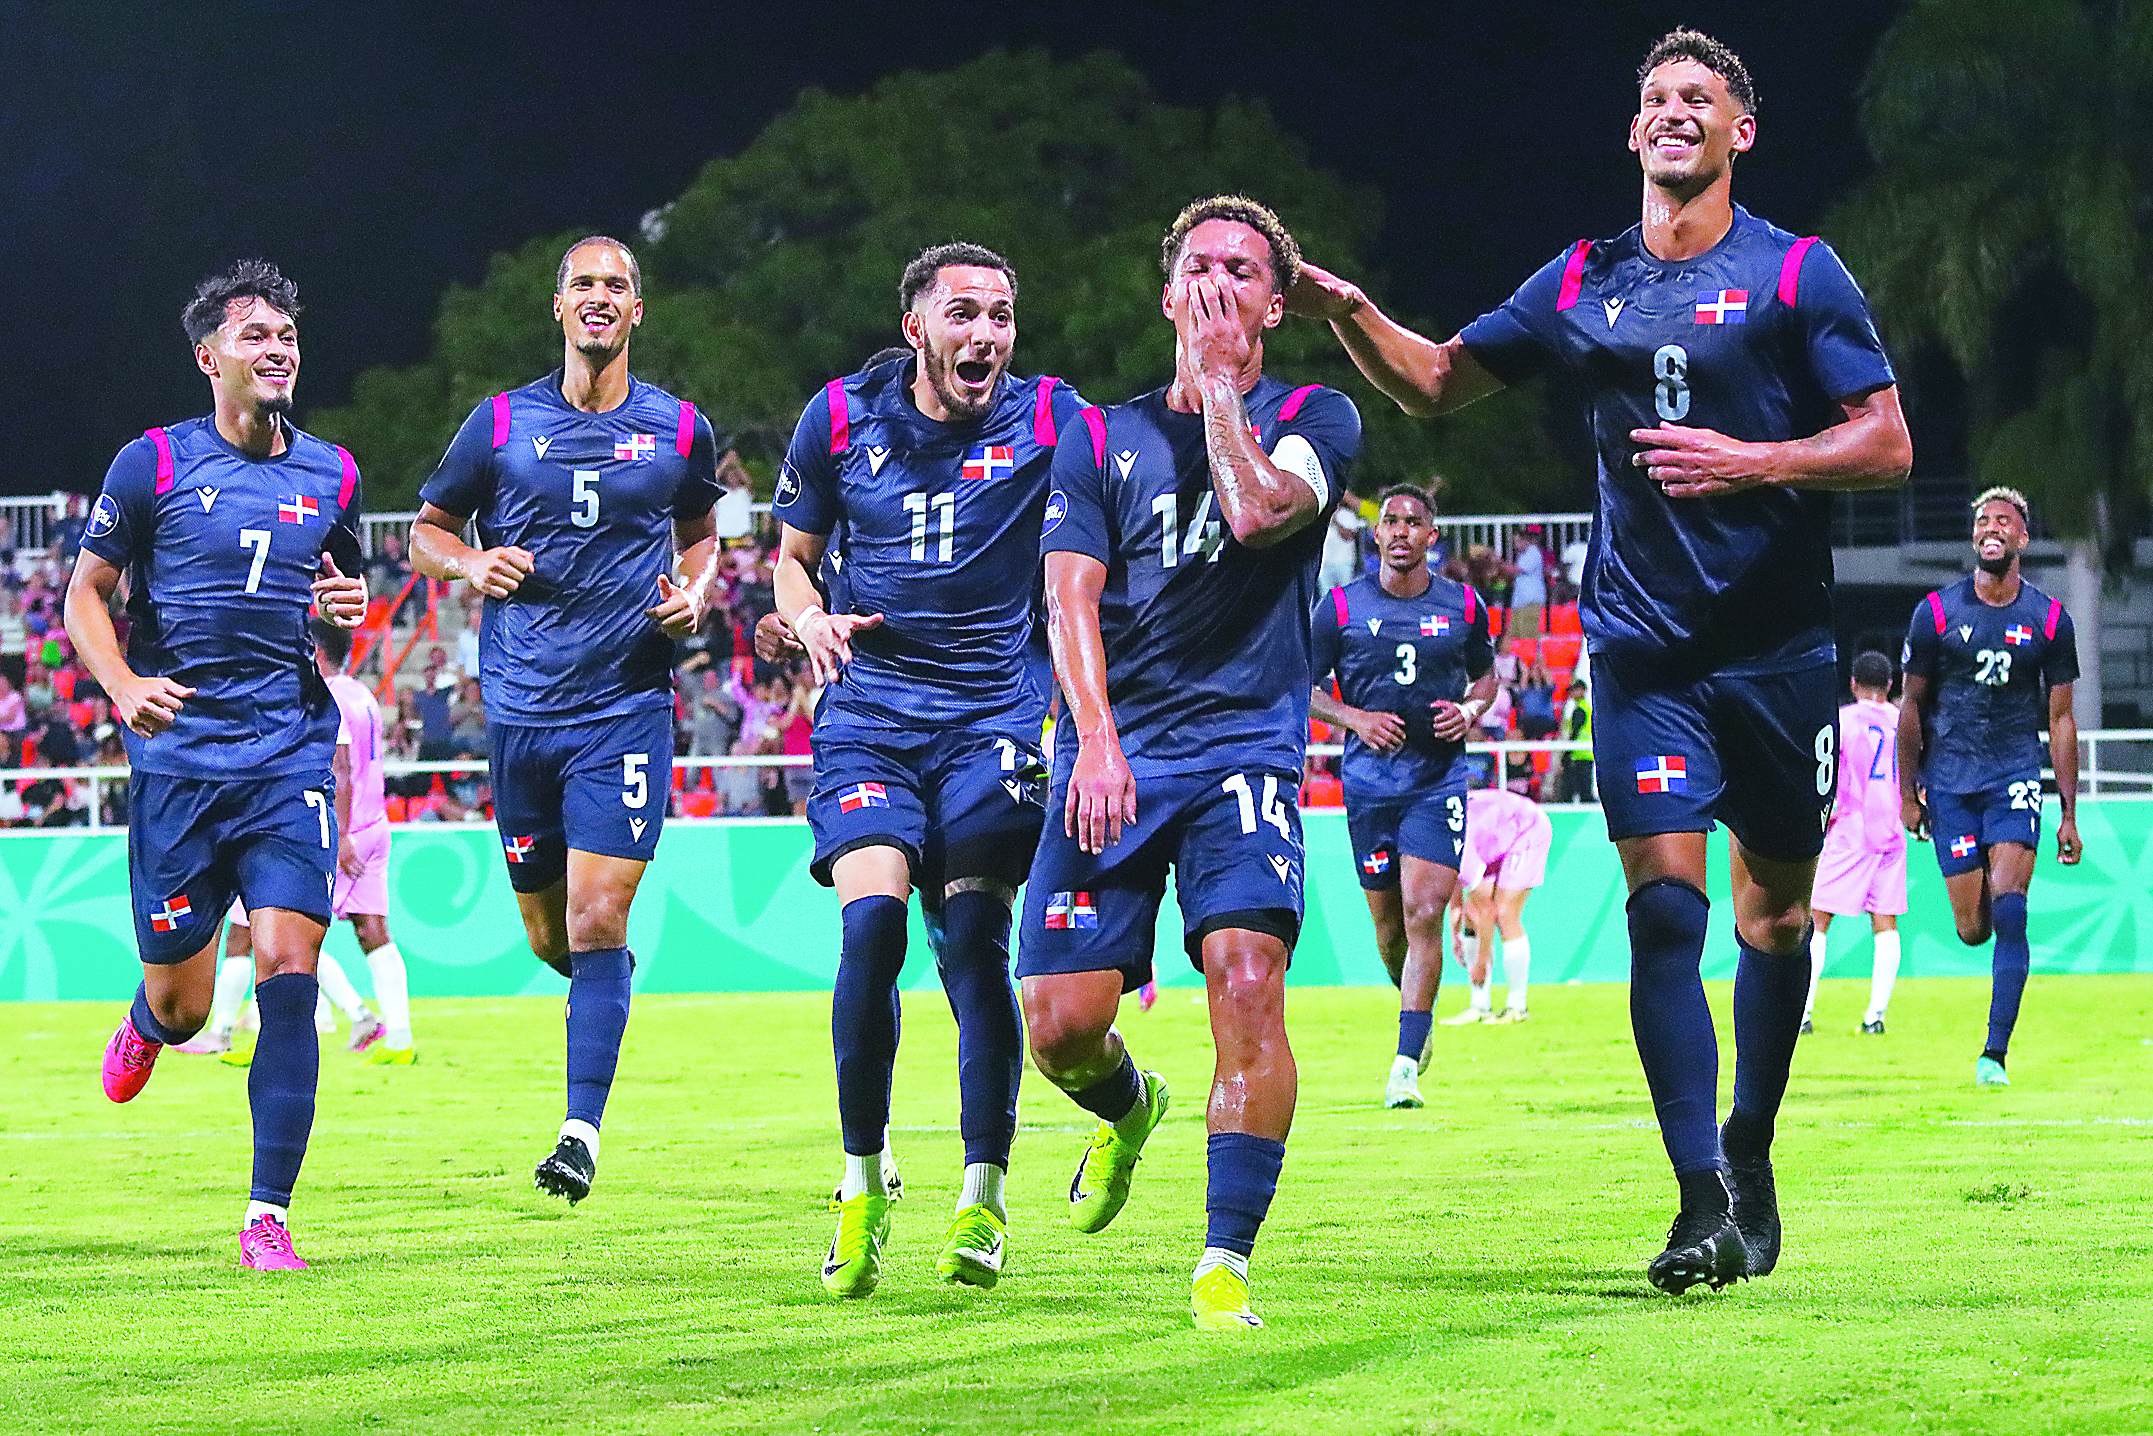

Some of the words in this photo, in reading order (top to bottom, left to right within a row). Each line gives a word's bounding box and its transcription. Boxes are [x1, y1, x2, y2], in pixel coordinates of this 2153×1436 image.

[1653, 344, 1691, 421] 8
[570, 469, 600, 528] 5
[902, 491, 955, 563] 11
[1151, 489, 1225, 569] 14
[239, 528, 272, 595] 7
[1394, 643, 1417, 685] 3
[1974, 649, 2013, 686] 23
[621, 753, 649, 809] 5
[1814, 724, 1834, 796] 8
[303, 790, 330, 848] 7
[1221, 772, 1291, 842] 14
[1446, 796, 1464, 832] 3
[2007, 779, 2042, 813] 23
